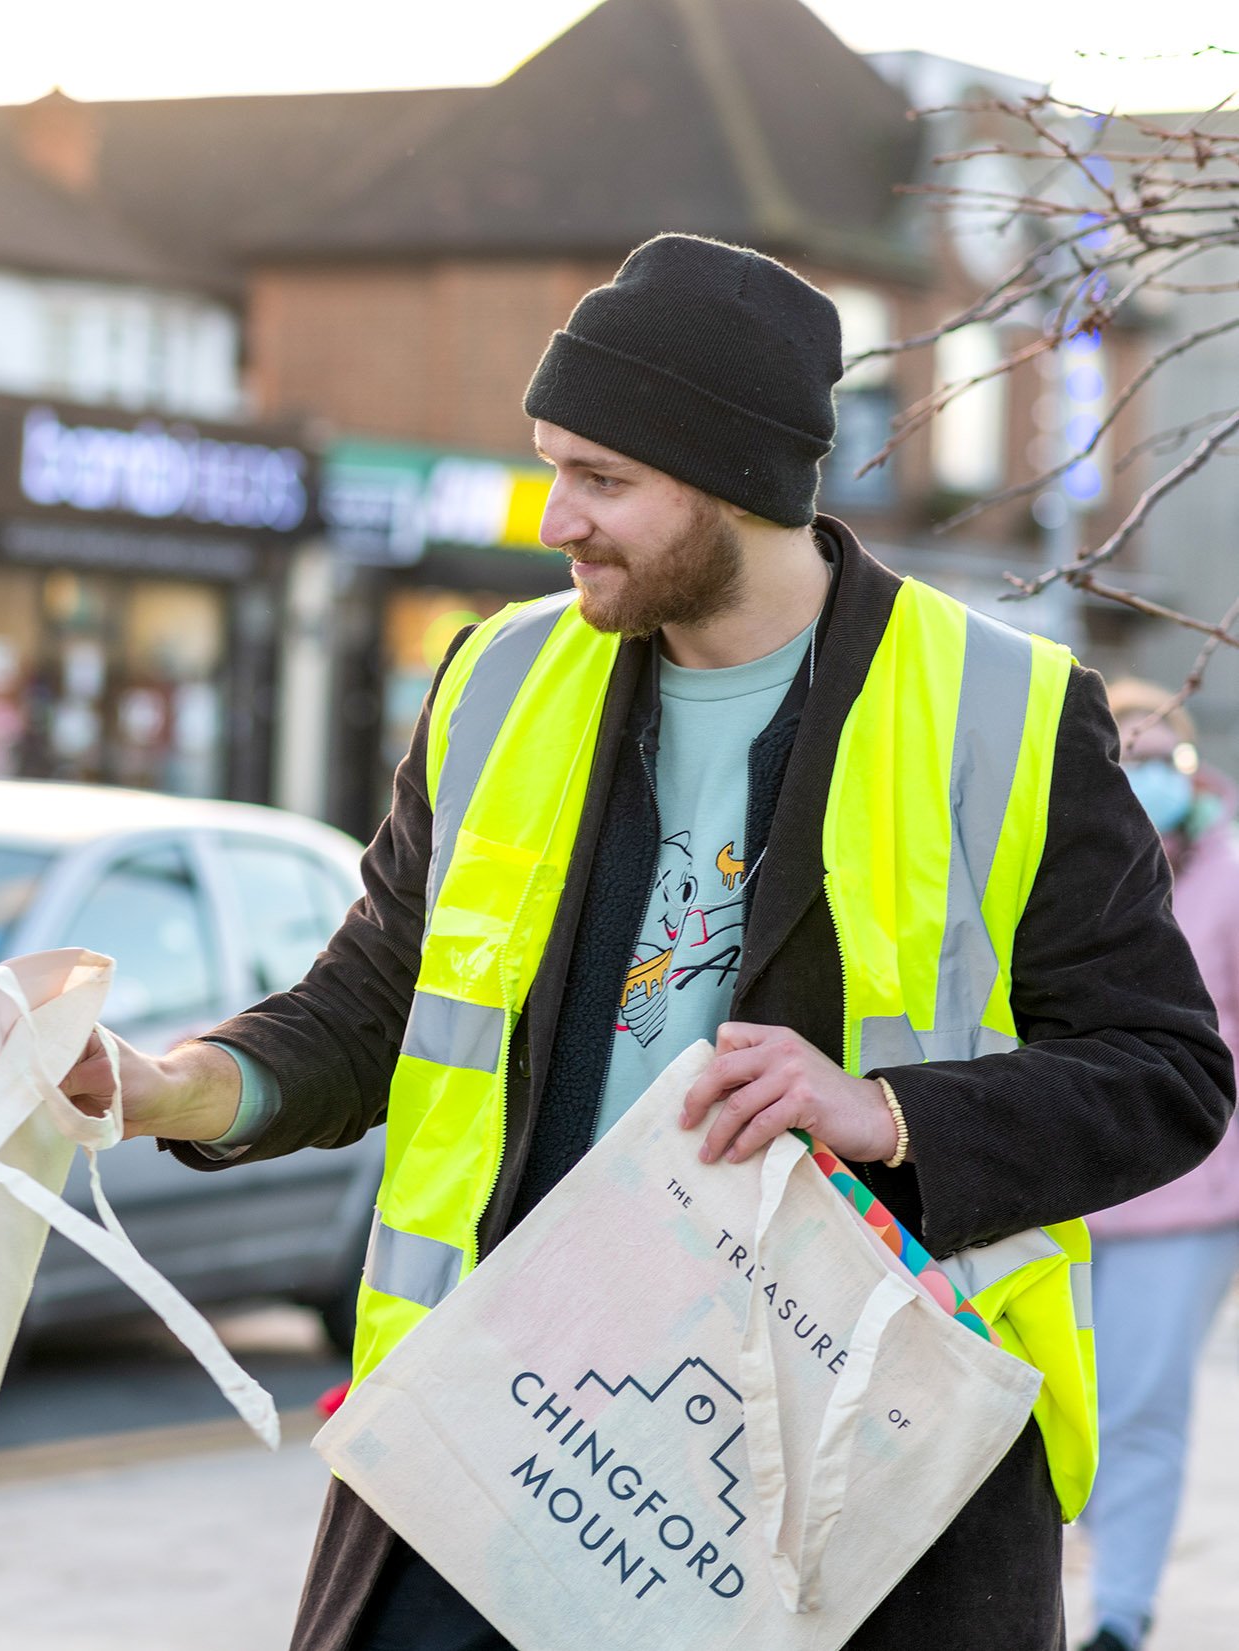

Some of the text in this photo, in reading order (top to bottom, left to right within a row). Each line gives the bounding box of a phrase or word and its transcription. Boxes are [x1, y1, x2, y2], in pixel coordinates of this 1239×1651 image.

[666, 1178, 693, 1209] THE
[888, 1408, 911, 1430] OF
[510, 1452, 667, 1600] MOUNT
[511, 1371, 745, 1599] CHINGFORD
